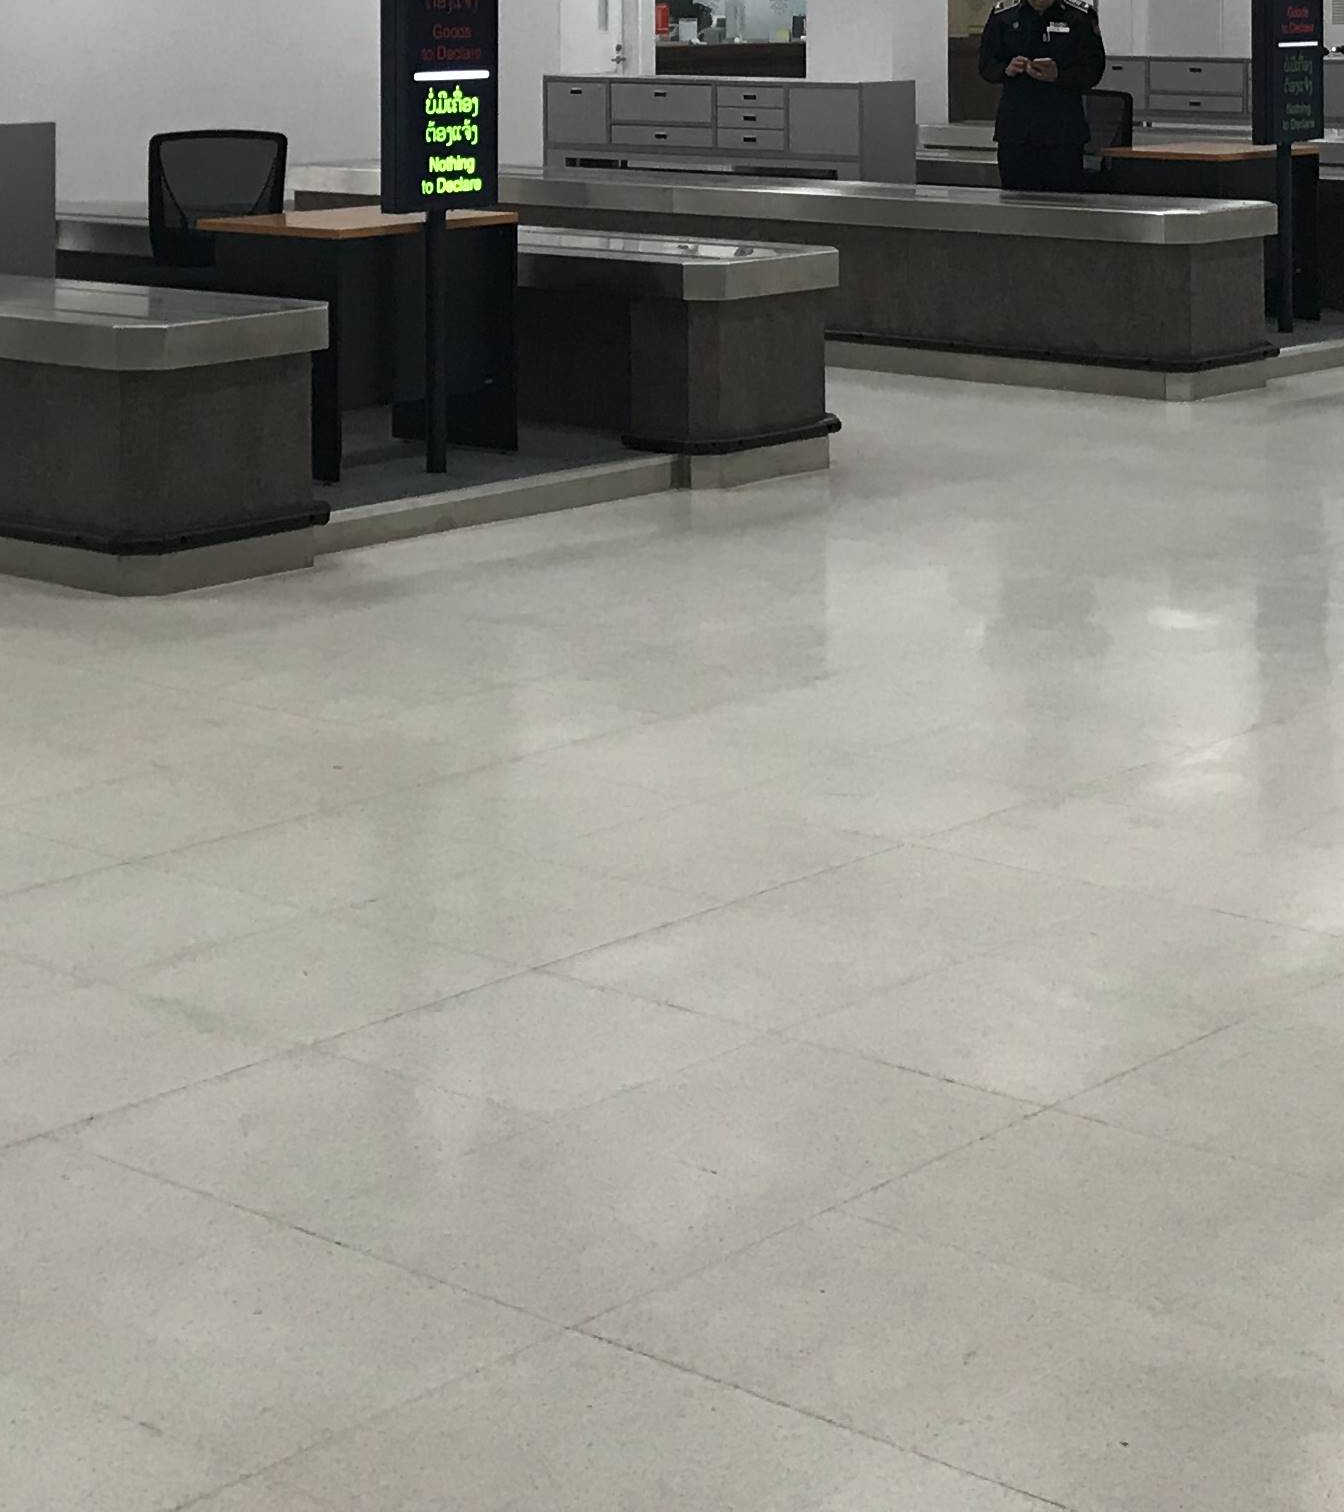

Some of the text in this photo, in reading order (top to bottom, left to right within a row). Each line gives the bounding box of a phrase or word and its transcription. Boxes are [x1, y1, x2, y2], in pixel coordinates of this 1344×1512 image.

[429, 154, 476, 174] Nothing
[421, 175, 482, 194] to Declare
